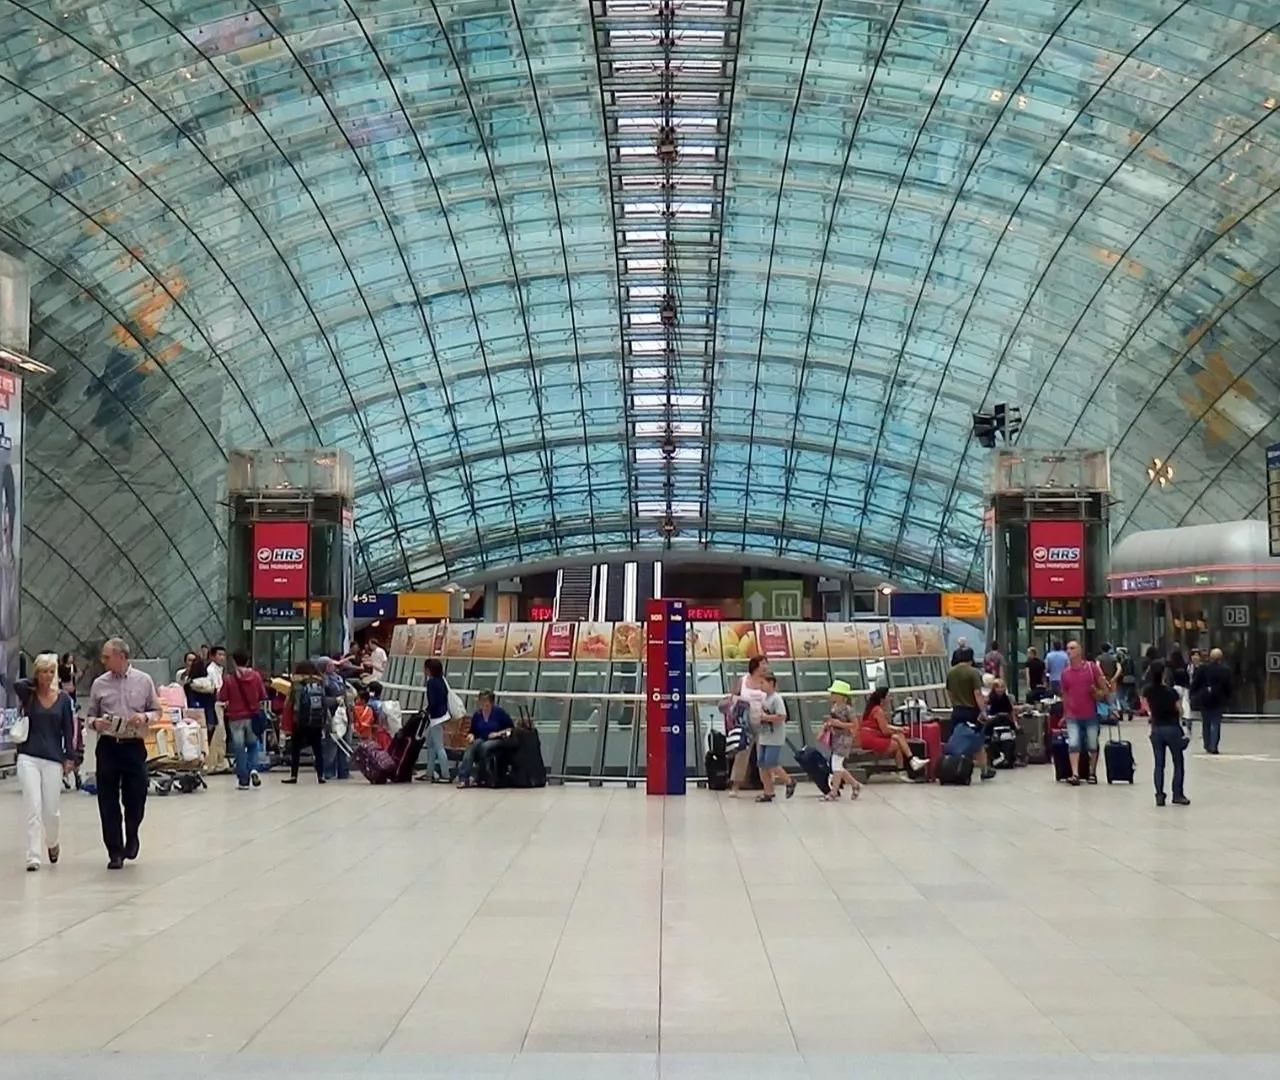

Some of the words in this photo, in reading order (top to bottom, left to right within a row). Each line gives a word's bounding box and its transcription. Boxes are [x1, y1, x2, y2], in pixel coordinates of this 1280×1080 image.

[272, 548, 304, 562] HRS
[1048, 547, 1080, 561] HRS
[531, 607, 553, 620] REW
[687, 608, 721, 619] REWE
[1226, 608, 1246, 623] DB
